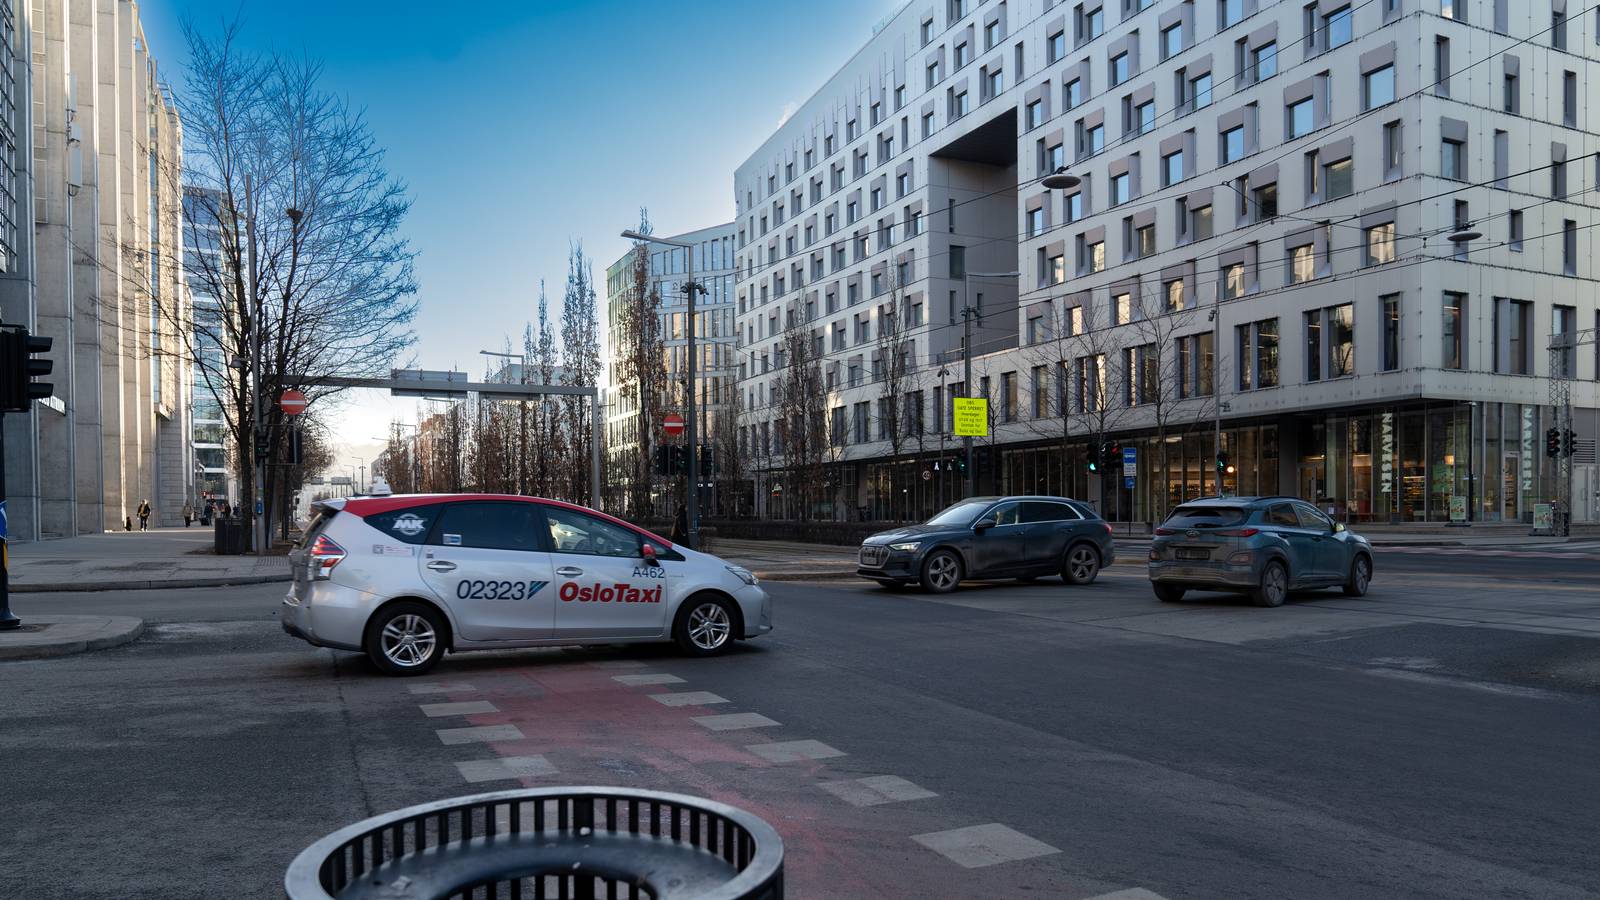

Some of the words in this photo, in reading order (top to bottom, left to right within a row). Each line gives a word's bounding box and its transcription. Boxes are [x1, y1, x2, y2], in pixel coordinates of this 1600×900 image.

[1381, 413, 1392, 492] NARVESEN
[1522, 408, 1532, 490] NARVESEN
[392, 519, 425, 529] MK
[632, 566, 665, 579] A462
[457, 580, 526, 600] 02323
[560, 581, 662, 603] OsloTaxi
